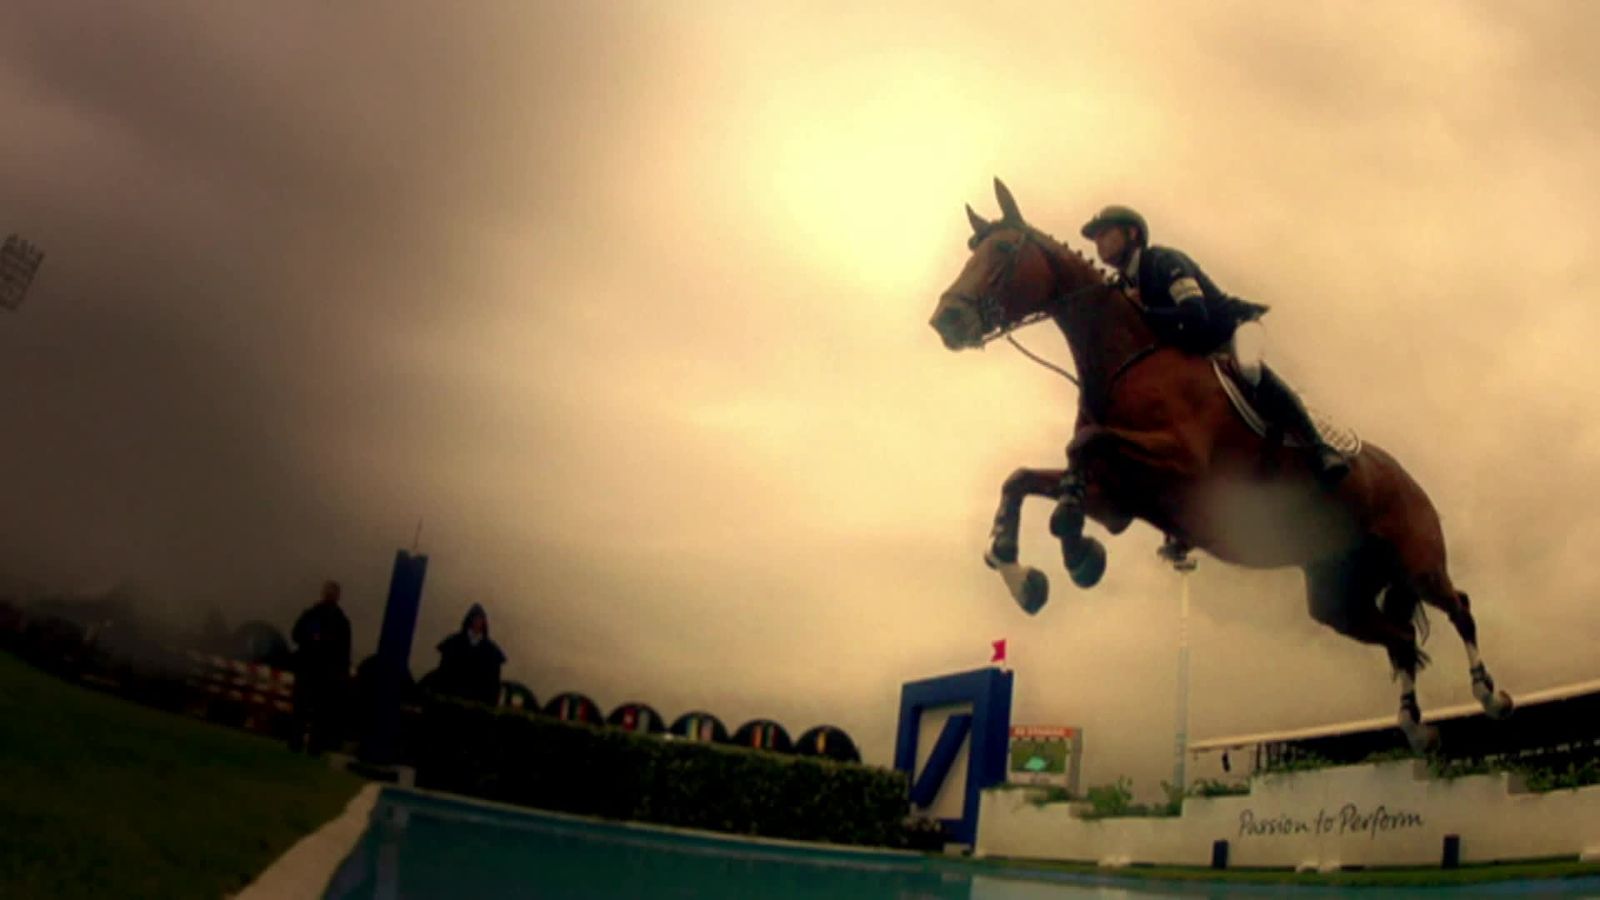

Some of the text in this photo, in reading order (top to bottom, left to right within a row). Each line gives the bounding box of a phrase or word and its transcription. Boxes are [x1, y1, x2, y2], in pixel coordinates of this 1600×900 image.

[1238, 802, 1425, 840] Passion to Perform
